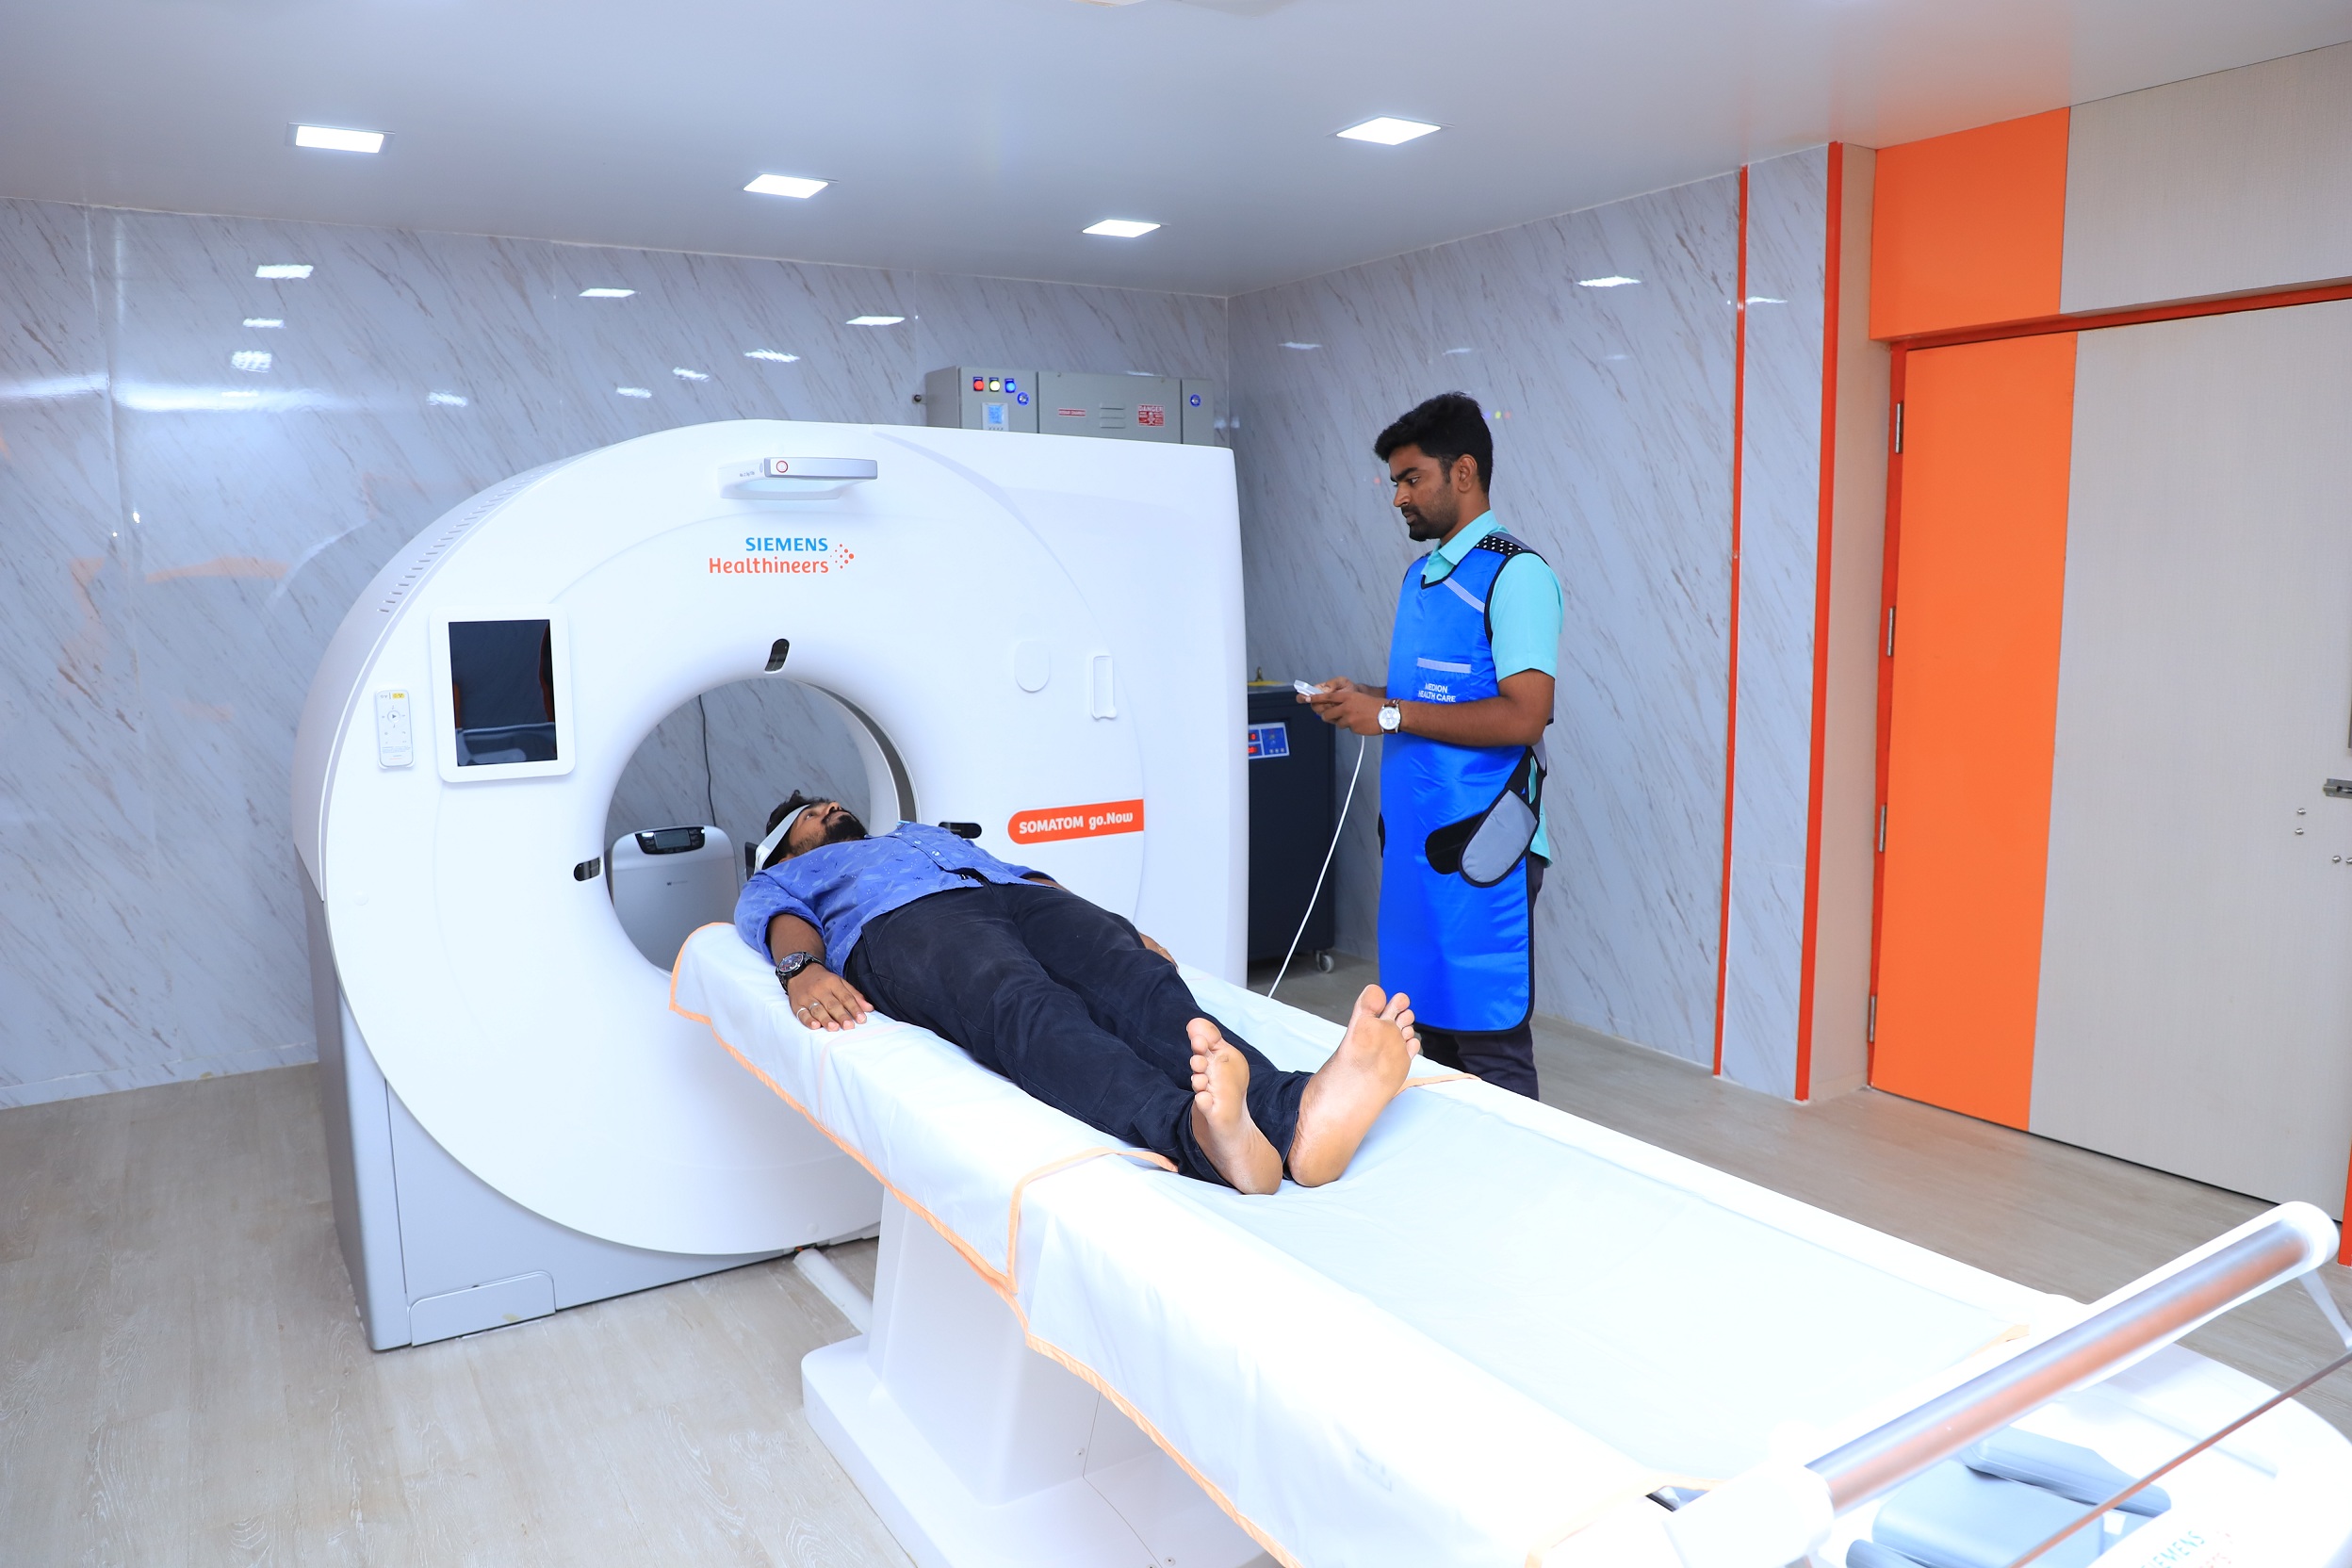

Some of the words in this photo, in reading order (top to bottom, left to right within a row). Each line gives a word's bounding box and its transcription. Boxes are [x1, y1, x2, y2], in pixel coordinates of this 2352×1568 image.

[745, 537, 828, 551] SIEMENS
[709, 556, 829, 573] Healthineers
[1425, 683, 1448, 694] MEDION
[1418, 690, 1436, 699] HEALTH
[1436, 694, 1456, 702] CARE
[1019, 815, 1085, 835] SOMATOM
[1088, 811, 1134, 830] go.Now
